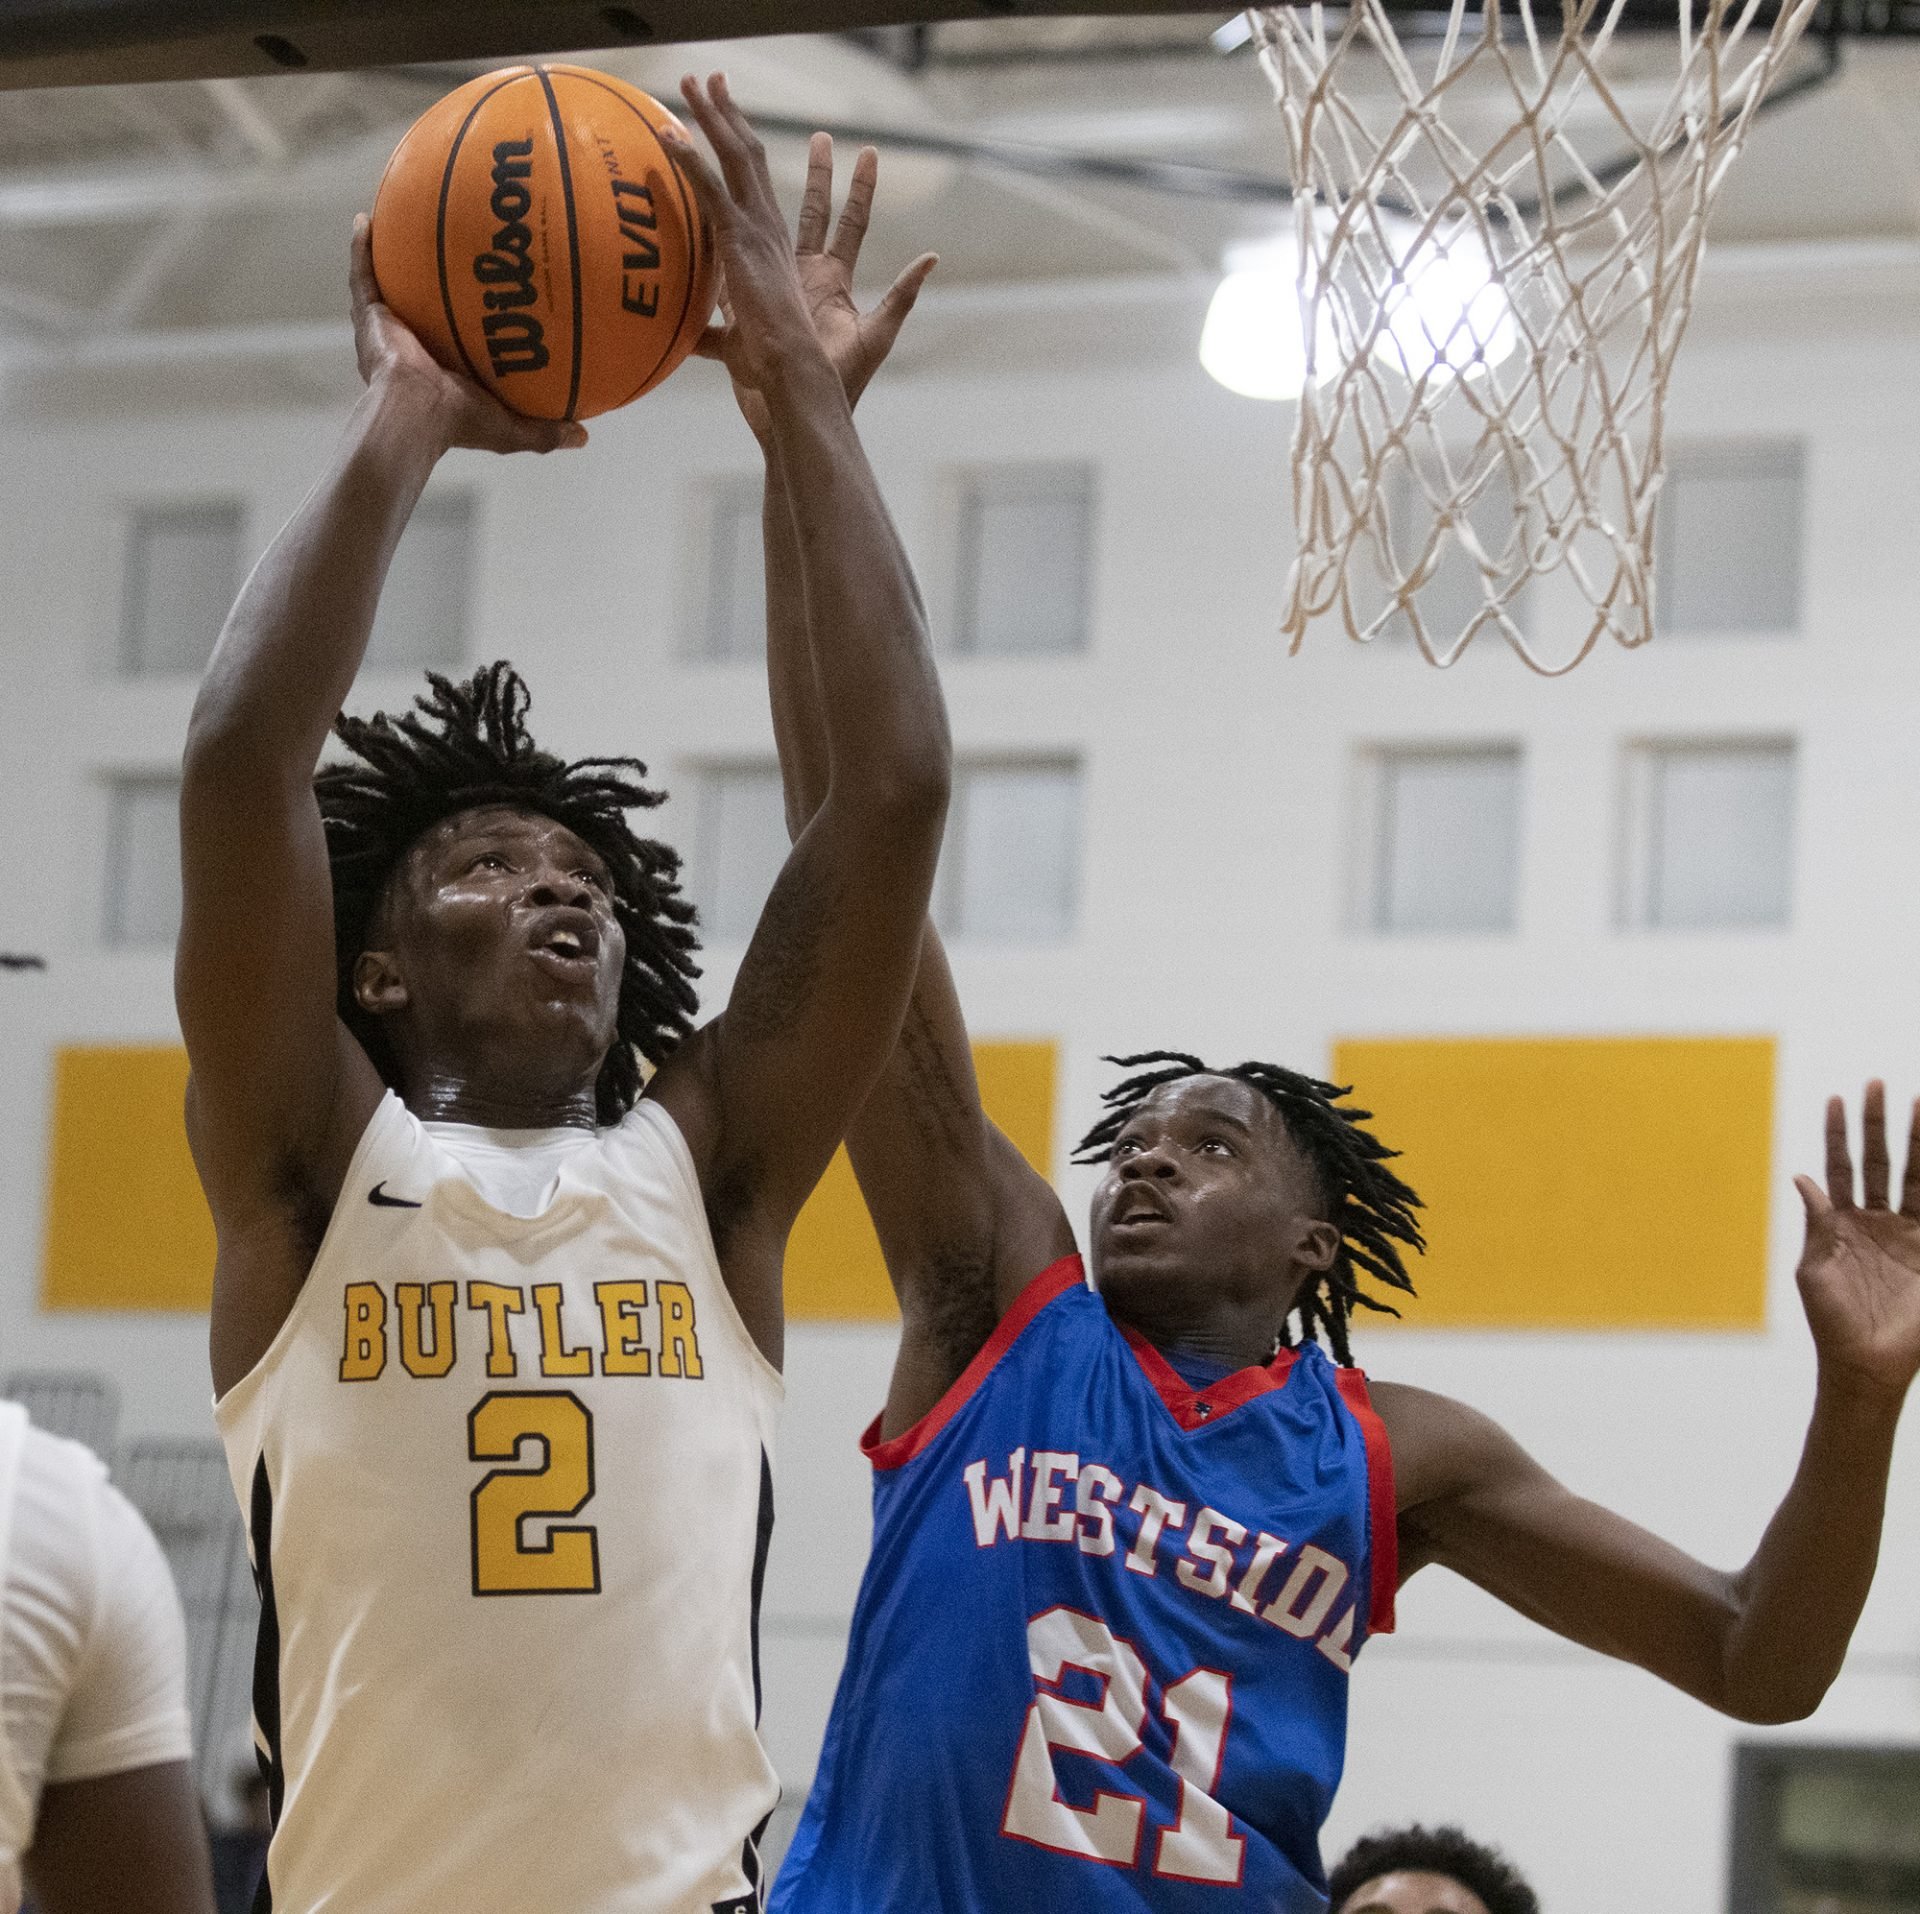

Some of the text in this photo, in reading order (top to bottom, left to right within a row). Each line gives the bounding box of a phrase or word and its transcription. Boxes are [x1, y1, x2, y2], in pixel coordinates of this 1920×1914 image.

[472, 136, 550, 378] Wilson
[611, 178, 661, 319] EVO
[338, 1279, 704, 1382] BUTLER
[467, 1389, 602, 1597] 2
[1000, 1603, 1247, 1888] 21
